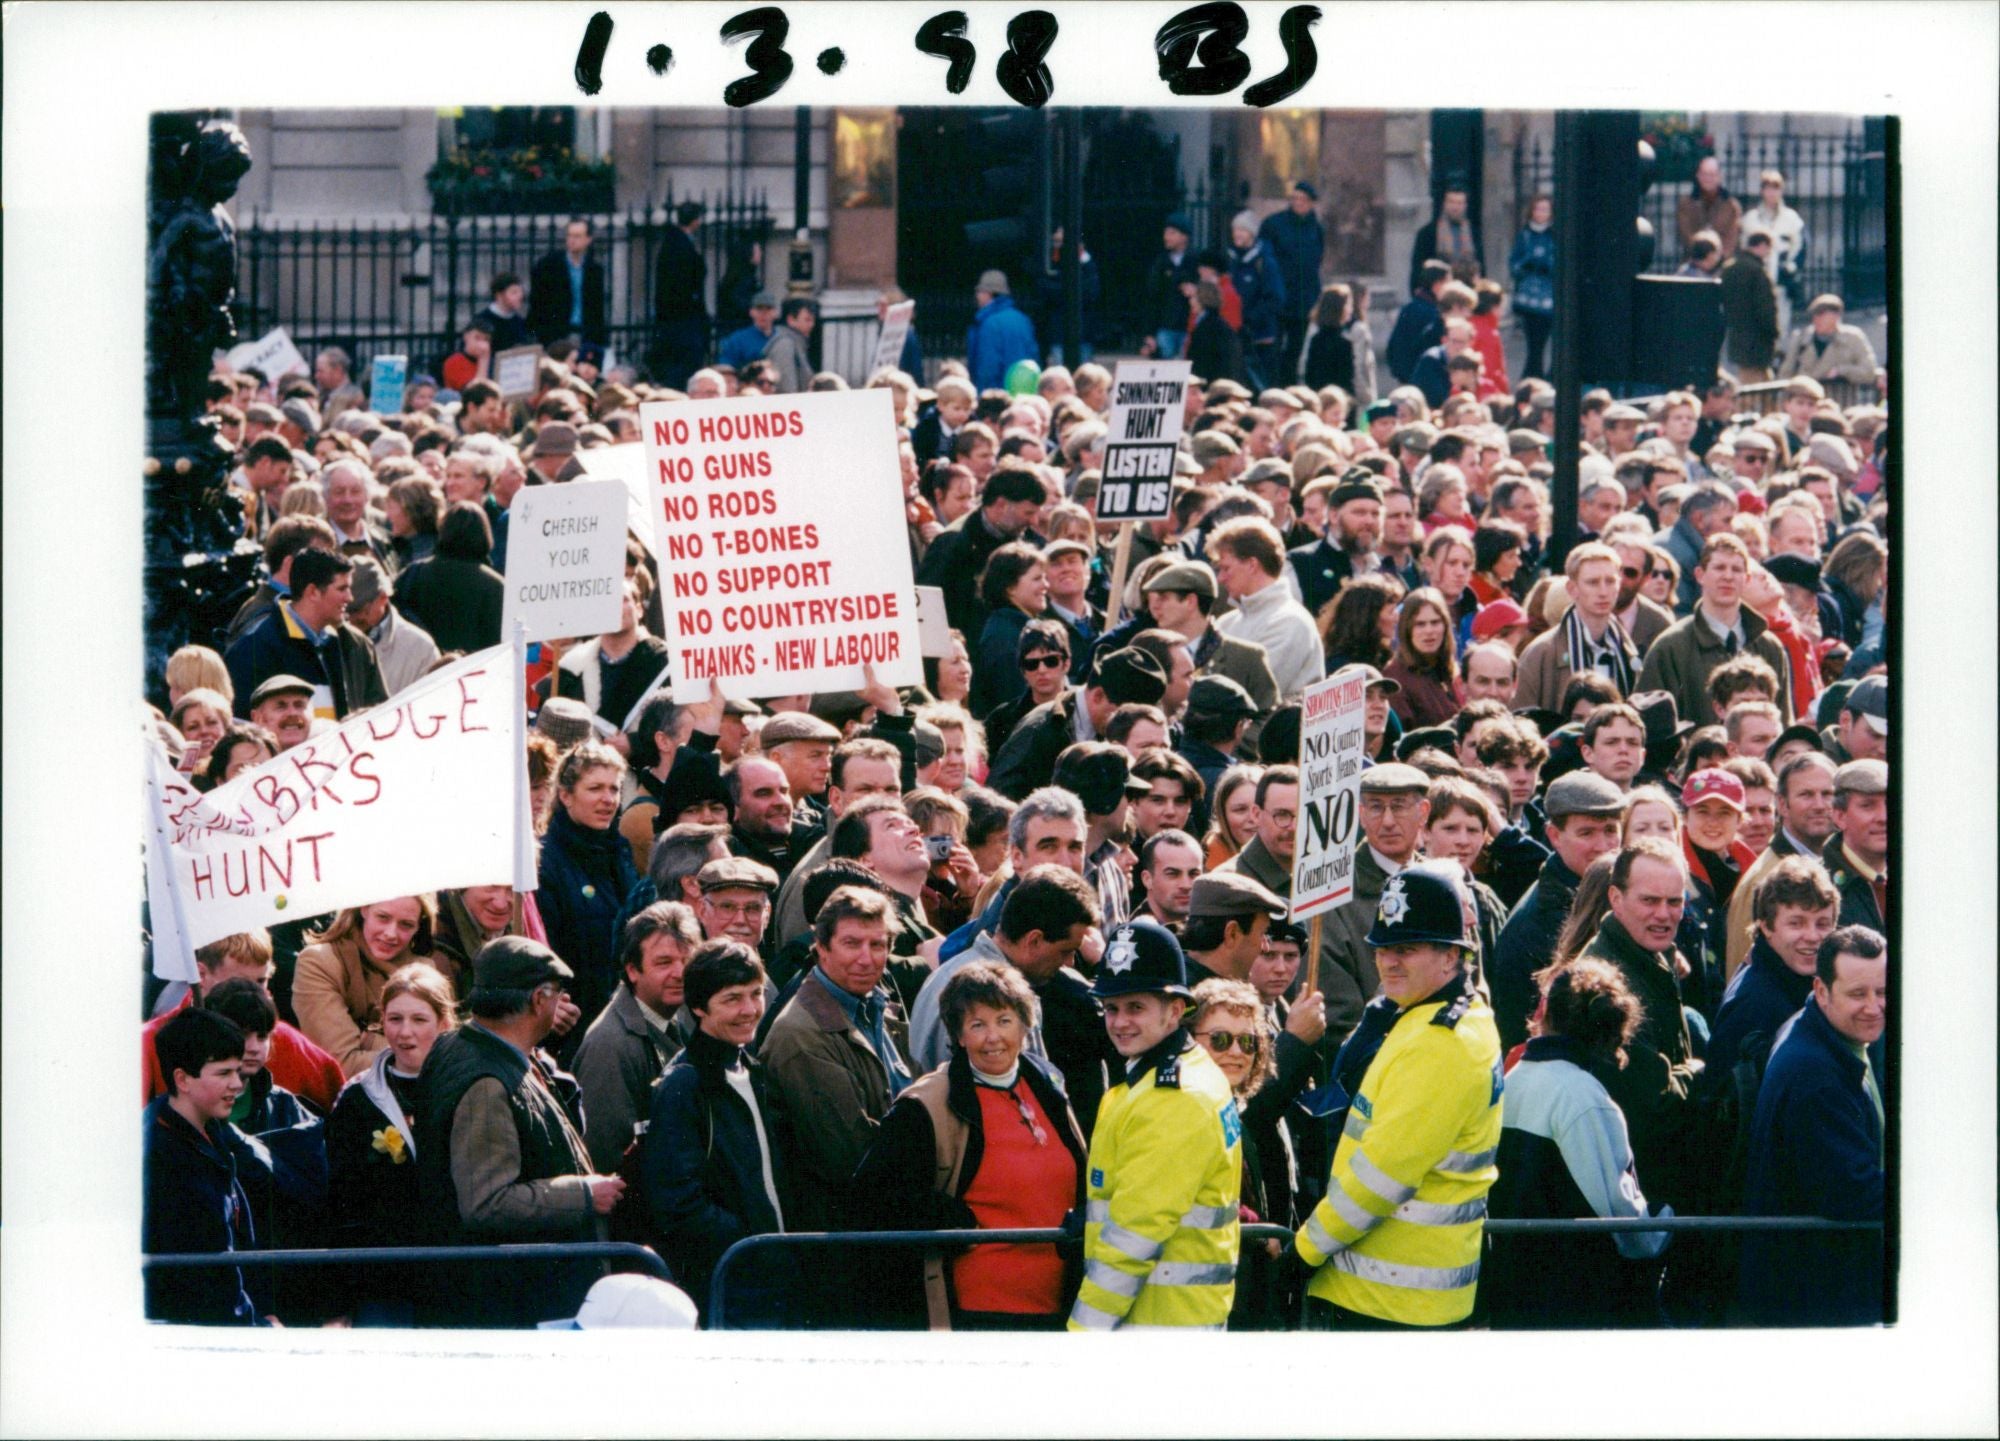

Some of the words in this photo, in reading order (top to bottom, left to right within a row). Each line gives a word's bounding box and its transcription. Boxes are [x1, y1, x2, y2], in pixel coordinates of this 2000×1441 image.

[1116, 381, 1184, 405] SINNINGTON
[654, 419, 689, 446] NO
[699, 410, 804, 443] HOUNDS
[1125, 408, 1166, 439] HUNT
[659, 457, 694, 484] NO
[703, 451, 772, 480] GUNS
[1106, 447, 1173, 478] LISTEN
[664, 495, 698, 522] NO
[708, 489, 777, 518] RODS
[1102, 483, 1131, 513] TO
[1135, 482, 1169, 512] US
[542, 516, 599, 538] CHERISH
[668, 533, 703, 560] NO
[713, 524, 819, 556] T-BONES
[549, 548, 589, 568] YOUR
[519, 577, 613, 603] COUNTRYSIDE
[673, 571, 708, 597] NO
[717, 561, 832, 594] SUPPORT
[678, 609, 712, 636] NO
[722, 592, 899, 632] COUNTRYSIDE
[681, 643, 756, 679] THANKS
[775, 638, 817, 671] NEW
[824, 631, 900, 667] LABOUR
[1306, 686, 1341, 718] SHOOTING
[1343, 677, 1363, 705] TIMES
[1304, 731, 1330, 763] NO
[1332, 727, 1361, 754] Country
[1306, 762, 1333, 796] Sports
[1301, 788, 1355, 858] NO
[192, 832, 335, 900] HUNT
[1297, 848, 1351, 894] Countryside
